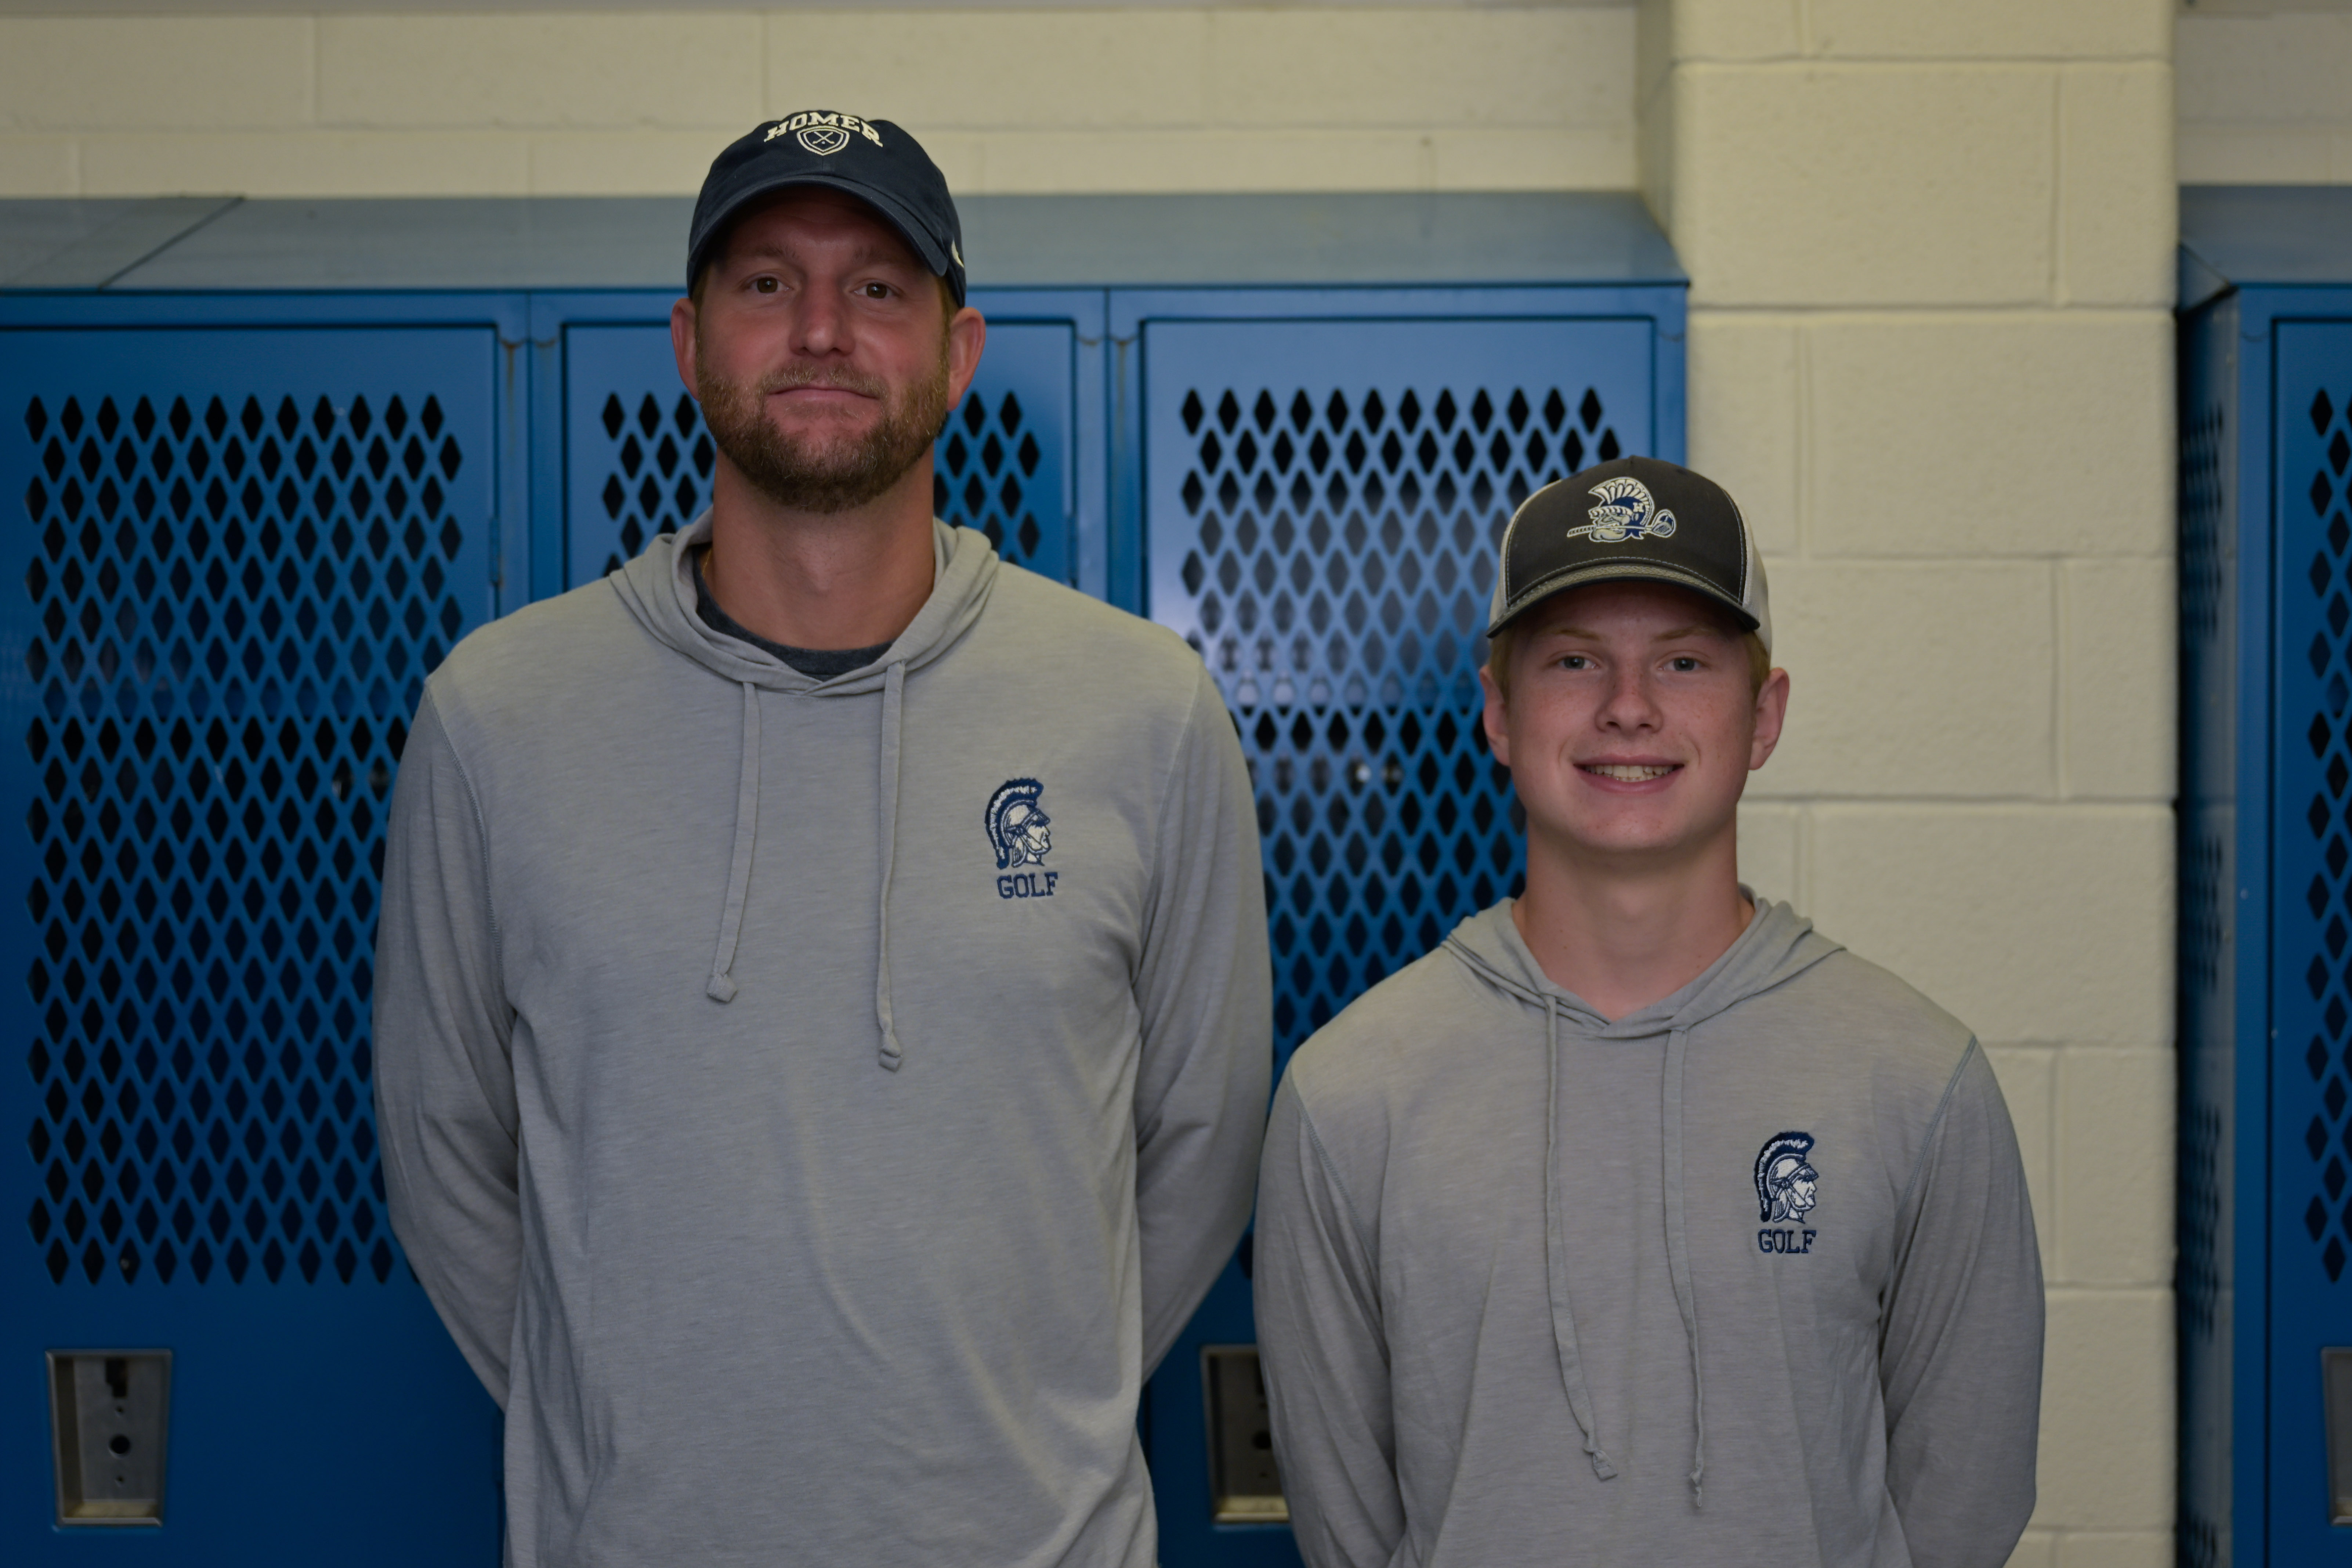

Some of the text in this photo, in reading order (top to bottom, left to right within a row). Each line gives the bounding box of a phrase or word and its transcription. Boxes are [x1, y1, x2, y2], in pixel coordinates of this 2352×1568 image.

[764, 112, 883, 147] HOMER
[1633, 503, 1644, 513] H
[997, 872, 1058, 899] GOLF
[1758, 1229, 1816, 1253] GOLF
